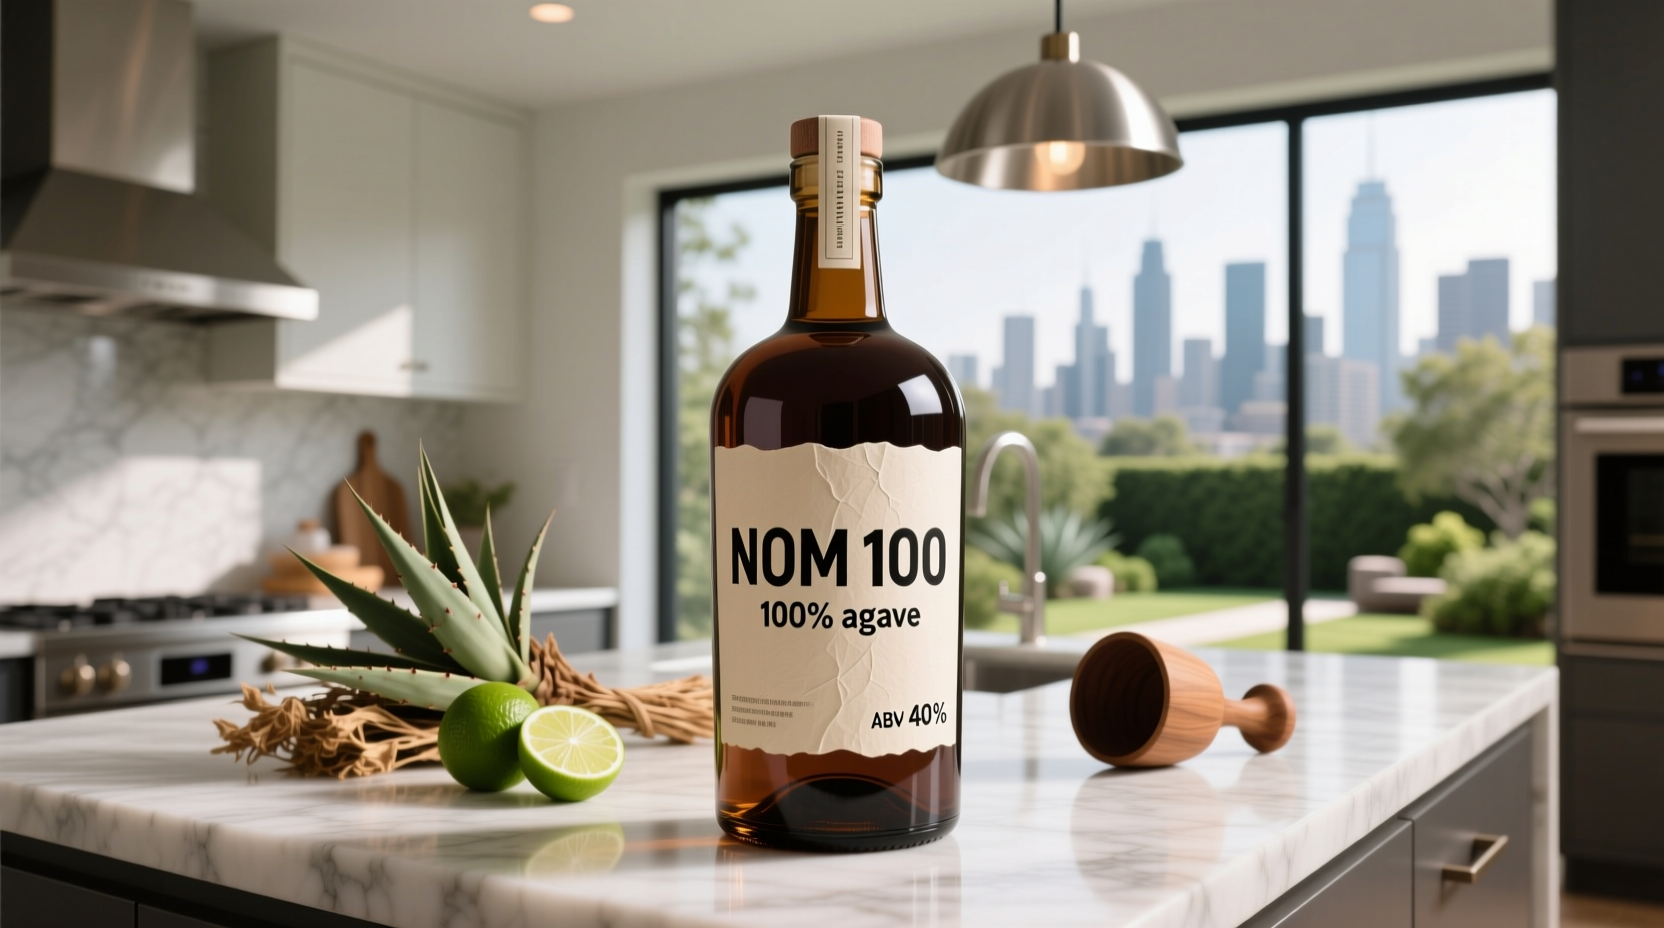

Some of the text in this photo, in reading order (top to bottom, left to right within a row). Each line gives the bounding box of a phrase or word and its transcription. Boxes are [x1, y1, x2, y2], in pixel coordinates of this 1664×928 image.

[732, 527, 946, 587] NOM 100
[760, 600, 921, 636] 100% agave
[871, 702, 947, 729] ABV 40%
